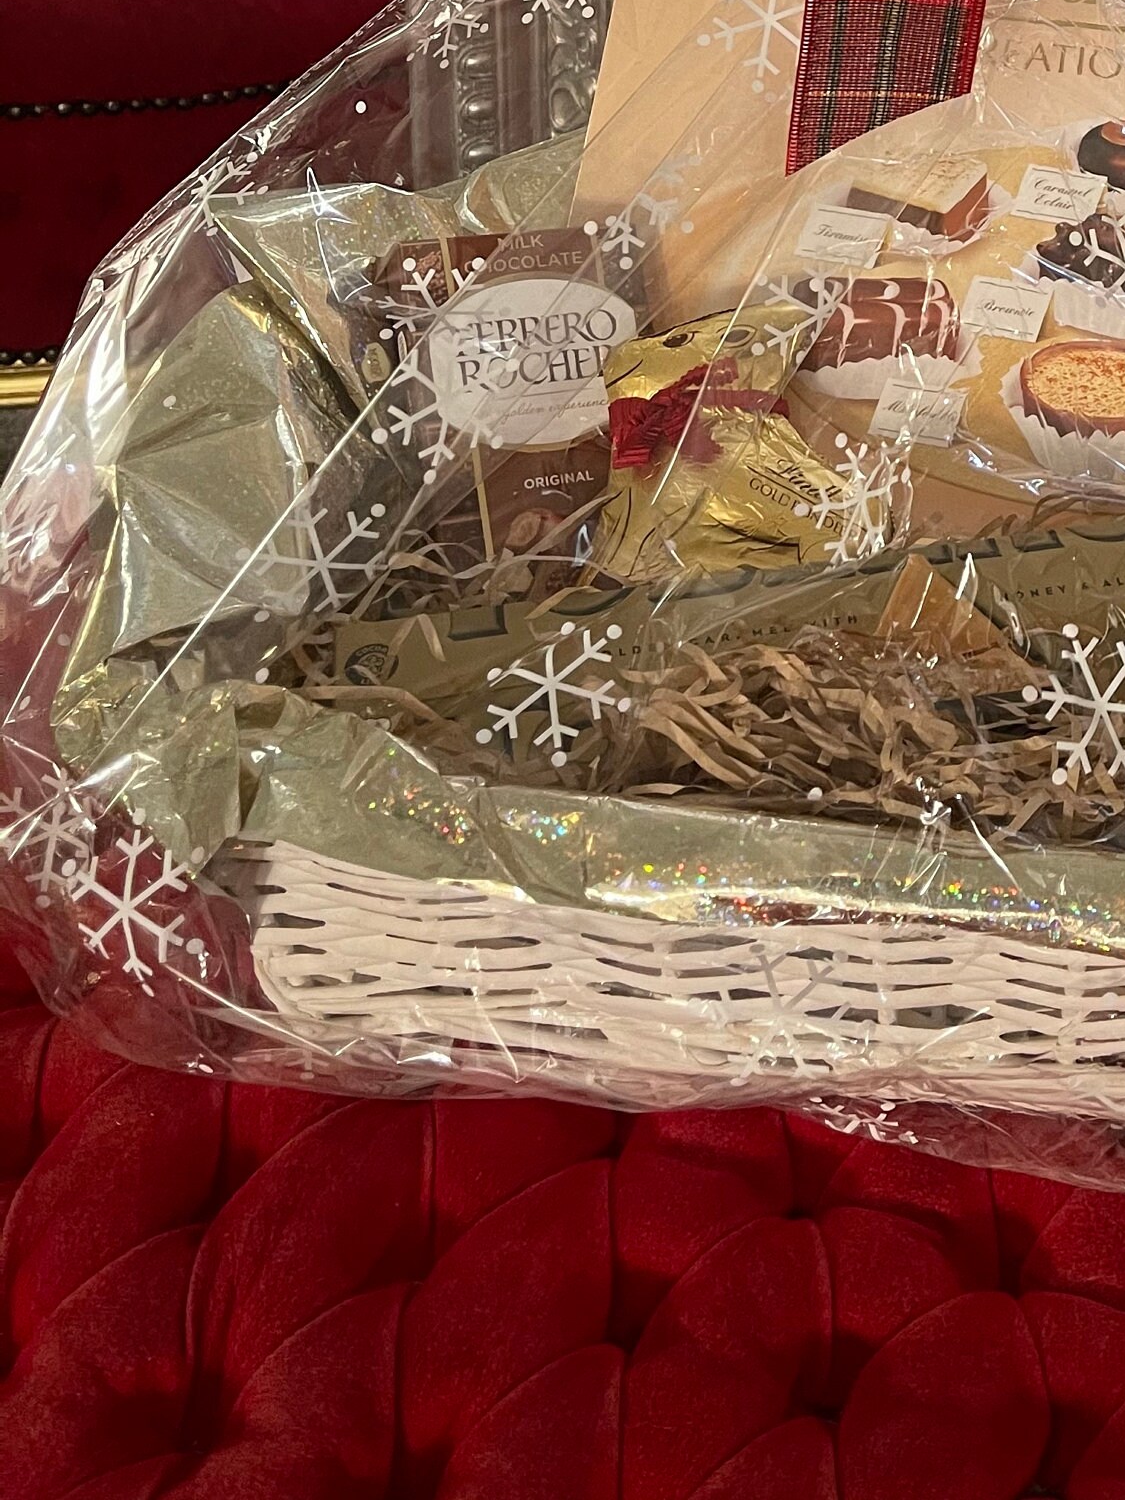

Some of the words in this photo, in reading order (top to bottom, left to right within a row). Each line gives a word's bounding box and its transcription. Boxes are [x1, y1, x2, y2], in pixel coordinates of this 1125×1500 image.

[1033, 177, 1096, 199] Caramel
[1033, 193, 1075, 212] Eclair
[497, 233, 545, 251] MILK
[977, 299, 1036, 319] Brownie
[549, 397, 610, 420] experienc
[523, 470, 595, 491] ORIGINAL
[749, 476, 792, 508] GOLD
[686, 626, 793, 647] CARMEL
